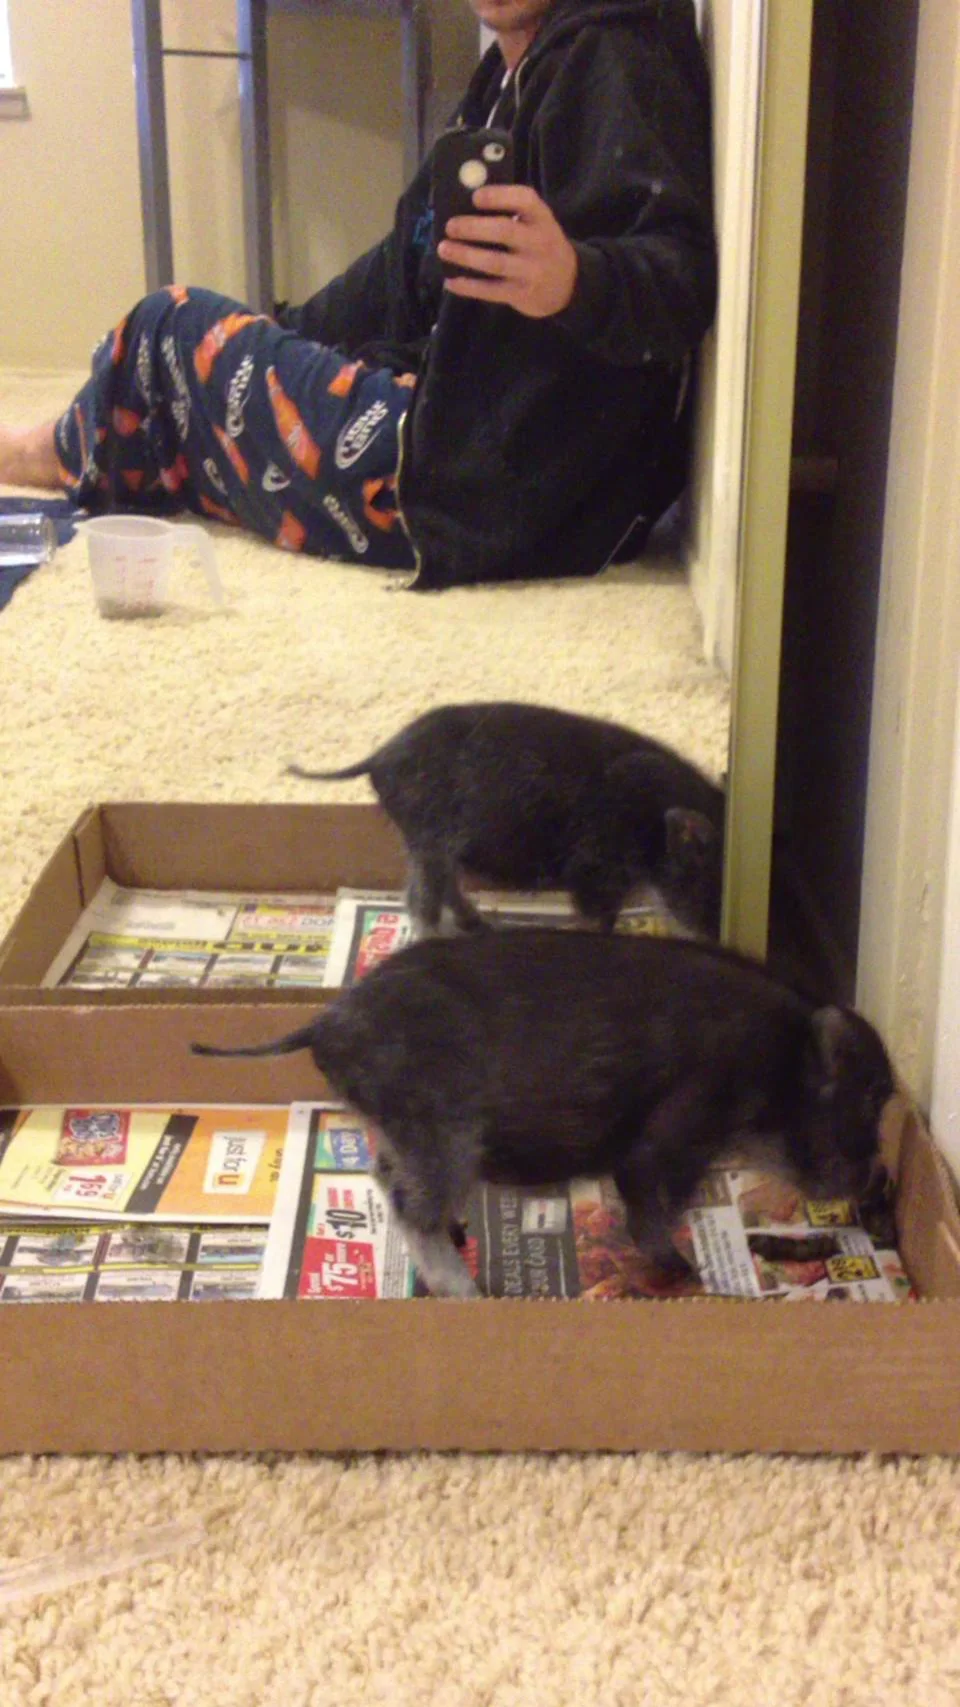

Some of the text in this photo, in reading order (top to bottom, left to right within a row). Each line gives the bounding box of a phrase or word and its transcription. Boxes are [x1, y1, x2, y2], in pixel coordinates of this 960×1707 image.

[325, 1209, 367, 1239] $10
[501, 1223, 520, 1256] EVERY
[321, 1262, 359, 1291] $75
[502, 1259, 523, 1294] DEALS
